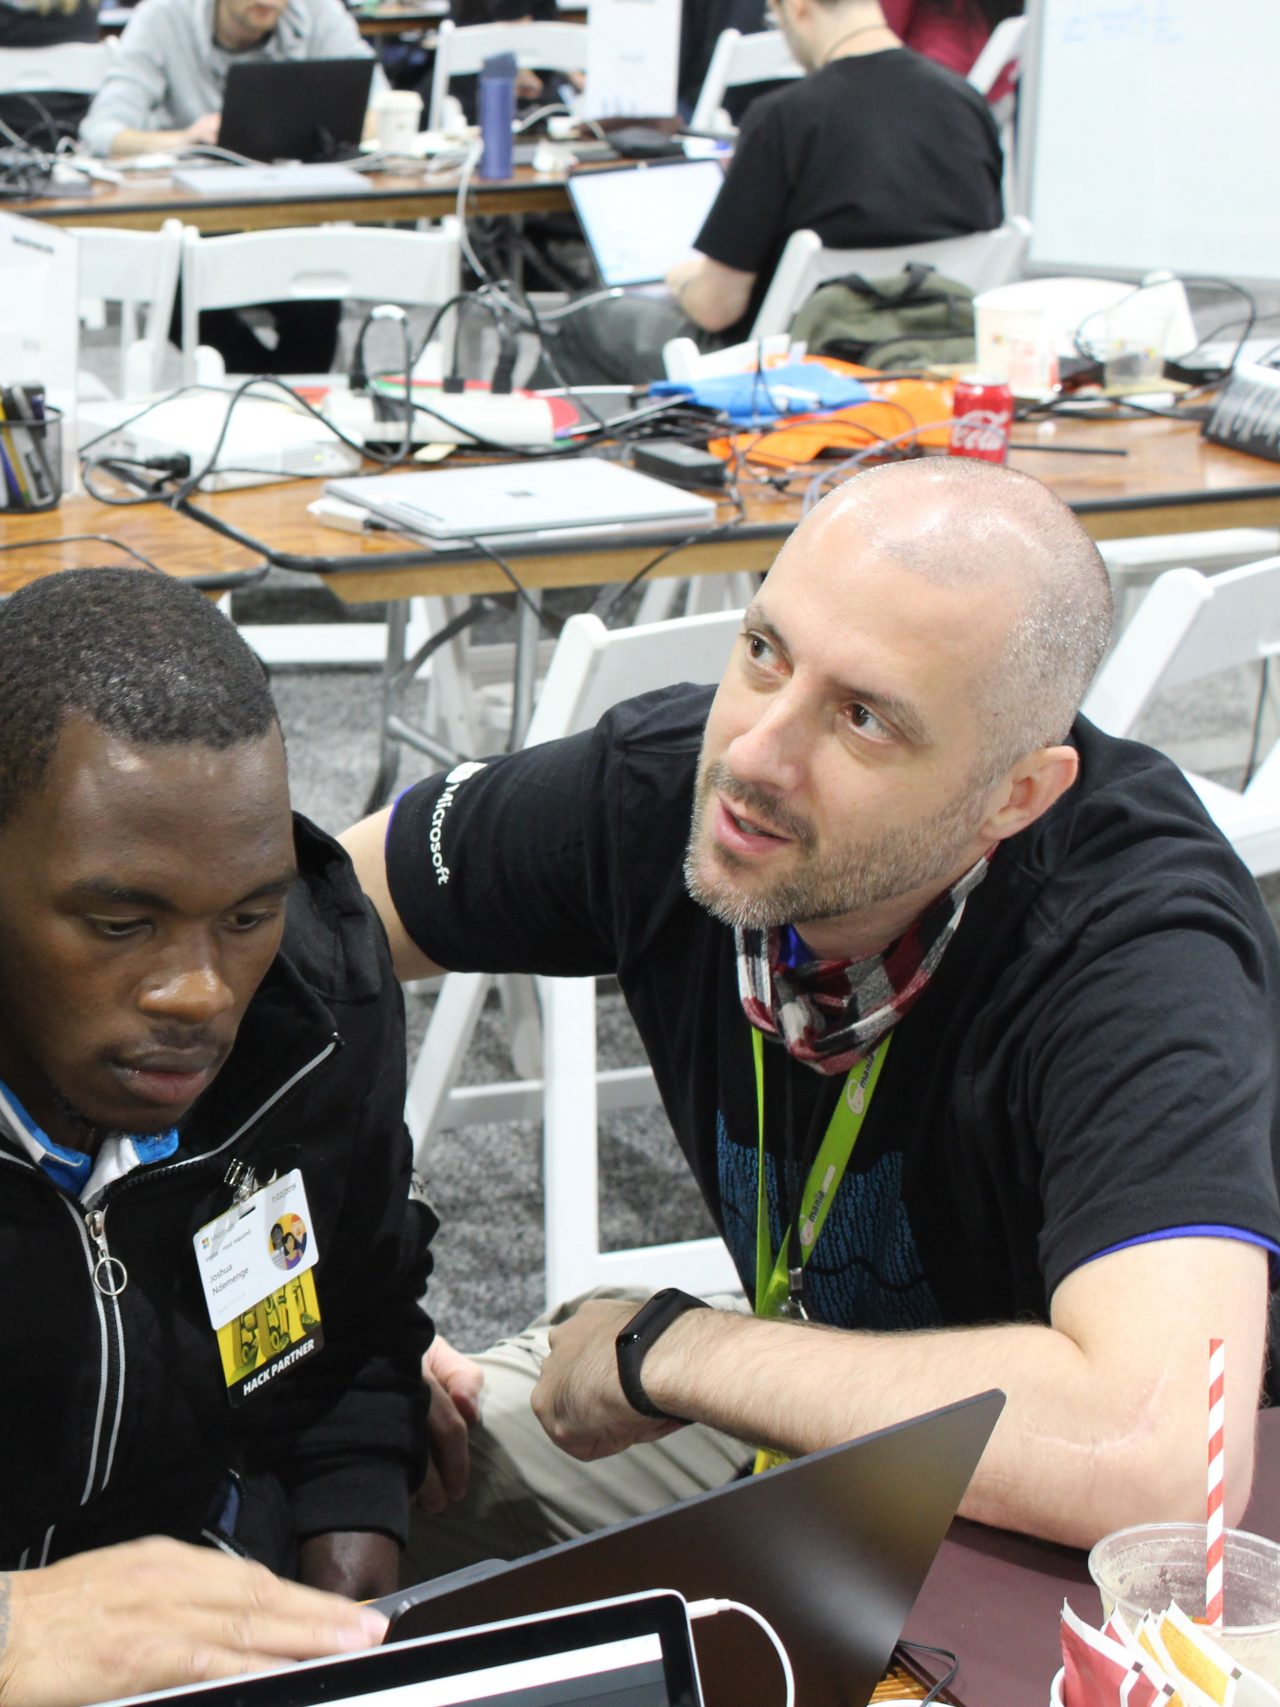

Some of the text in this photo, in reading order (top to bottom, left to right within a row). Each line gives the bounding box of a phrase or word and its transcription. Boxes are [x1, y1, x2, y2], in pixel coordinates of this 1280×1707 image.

[429, 783, 460, 886] Microsoft
[210, 1264, 233, 1284] Joshua
[243, 1337, 315, 1396] HACK PARTNER
